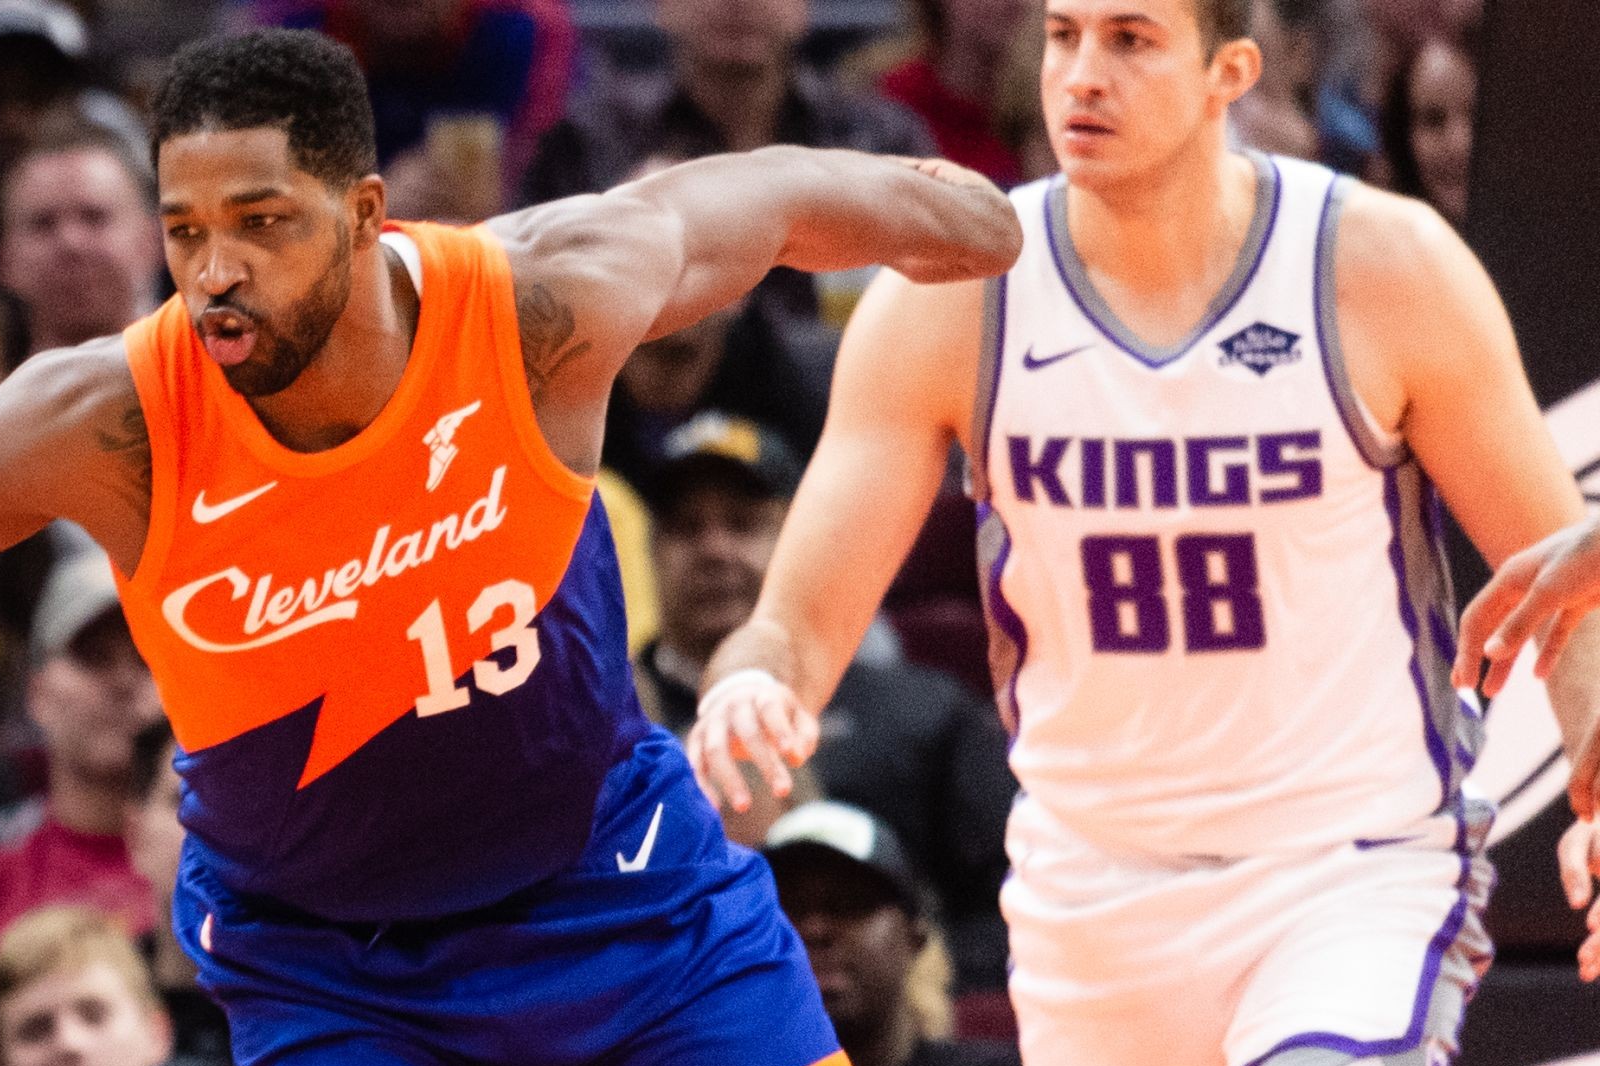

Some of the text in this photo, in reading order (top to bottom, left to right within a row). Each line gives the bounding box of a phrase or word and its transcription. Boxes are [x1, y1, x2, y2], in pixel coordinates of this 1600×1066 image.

[1005, 429, 1323, 509] KINGS
[161, 464, 508, 653] Cleveland
[1079, 532, 1267, 655] 88
[406, 578, 542, 718] 13
